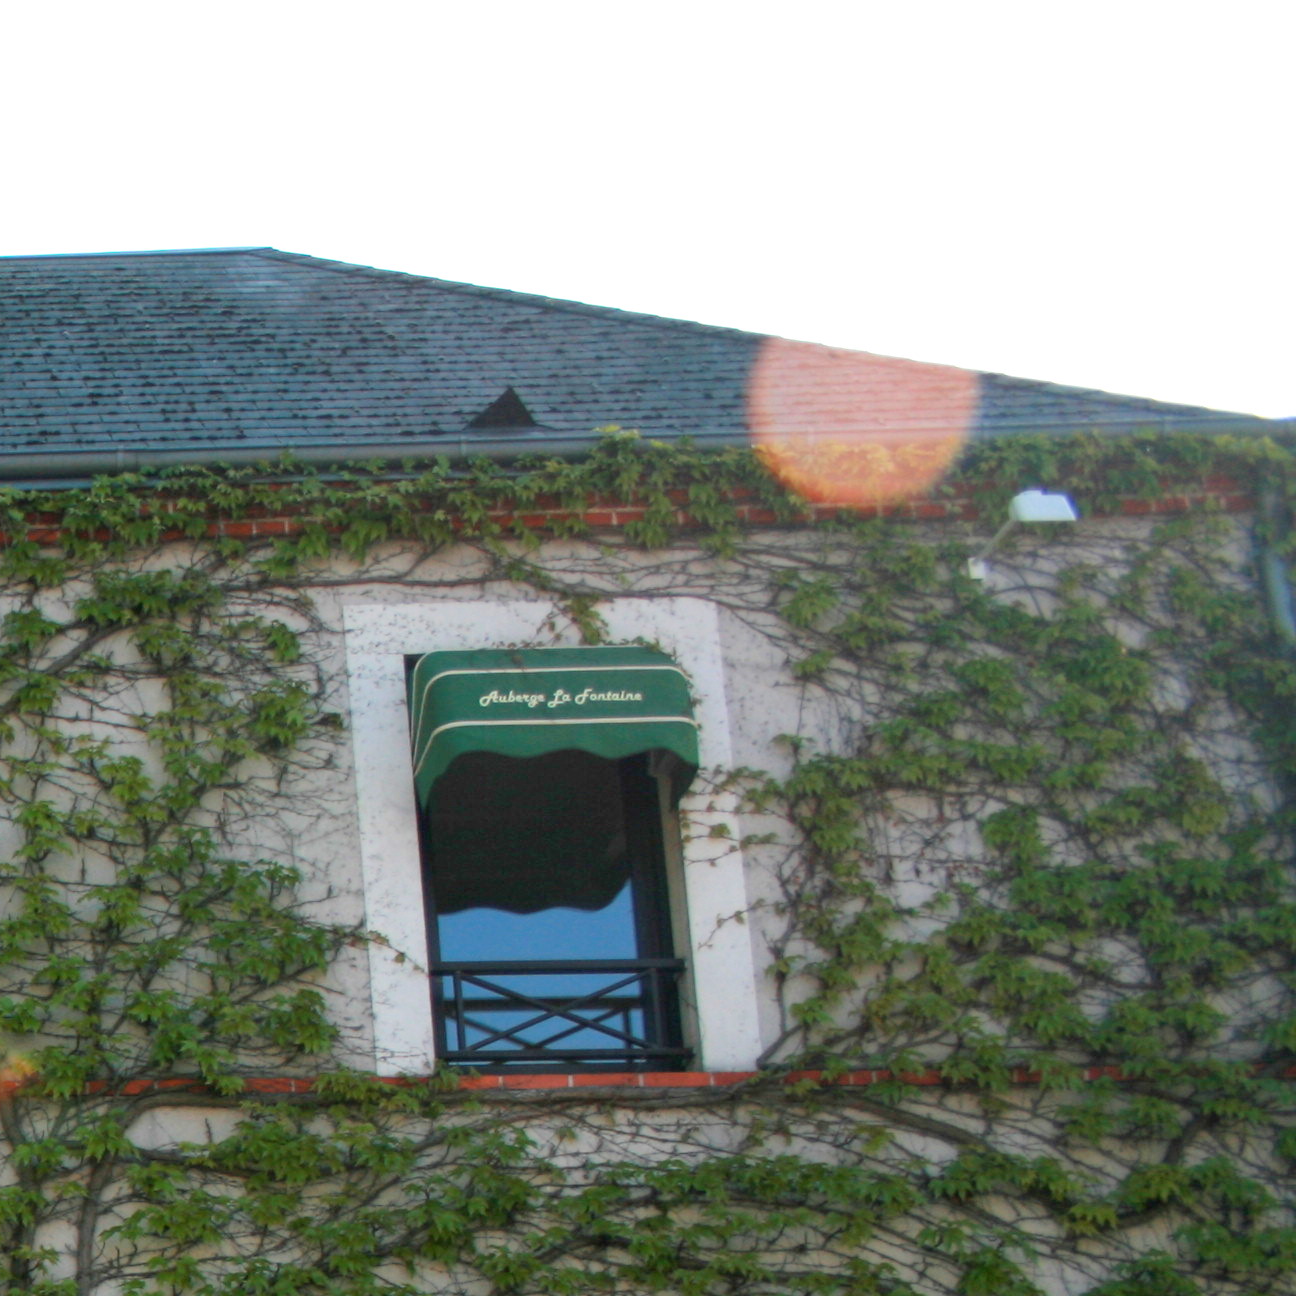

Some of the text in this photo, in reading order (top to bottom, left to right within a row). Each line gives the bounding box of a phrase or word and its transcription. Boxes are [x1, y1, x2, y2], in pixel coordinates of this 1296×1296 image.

[479, 687, 643, 708] Auberge La Fontaine
